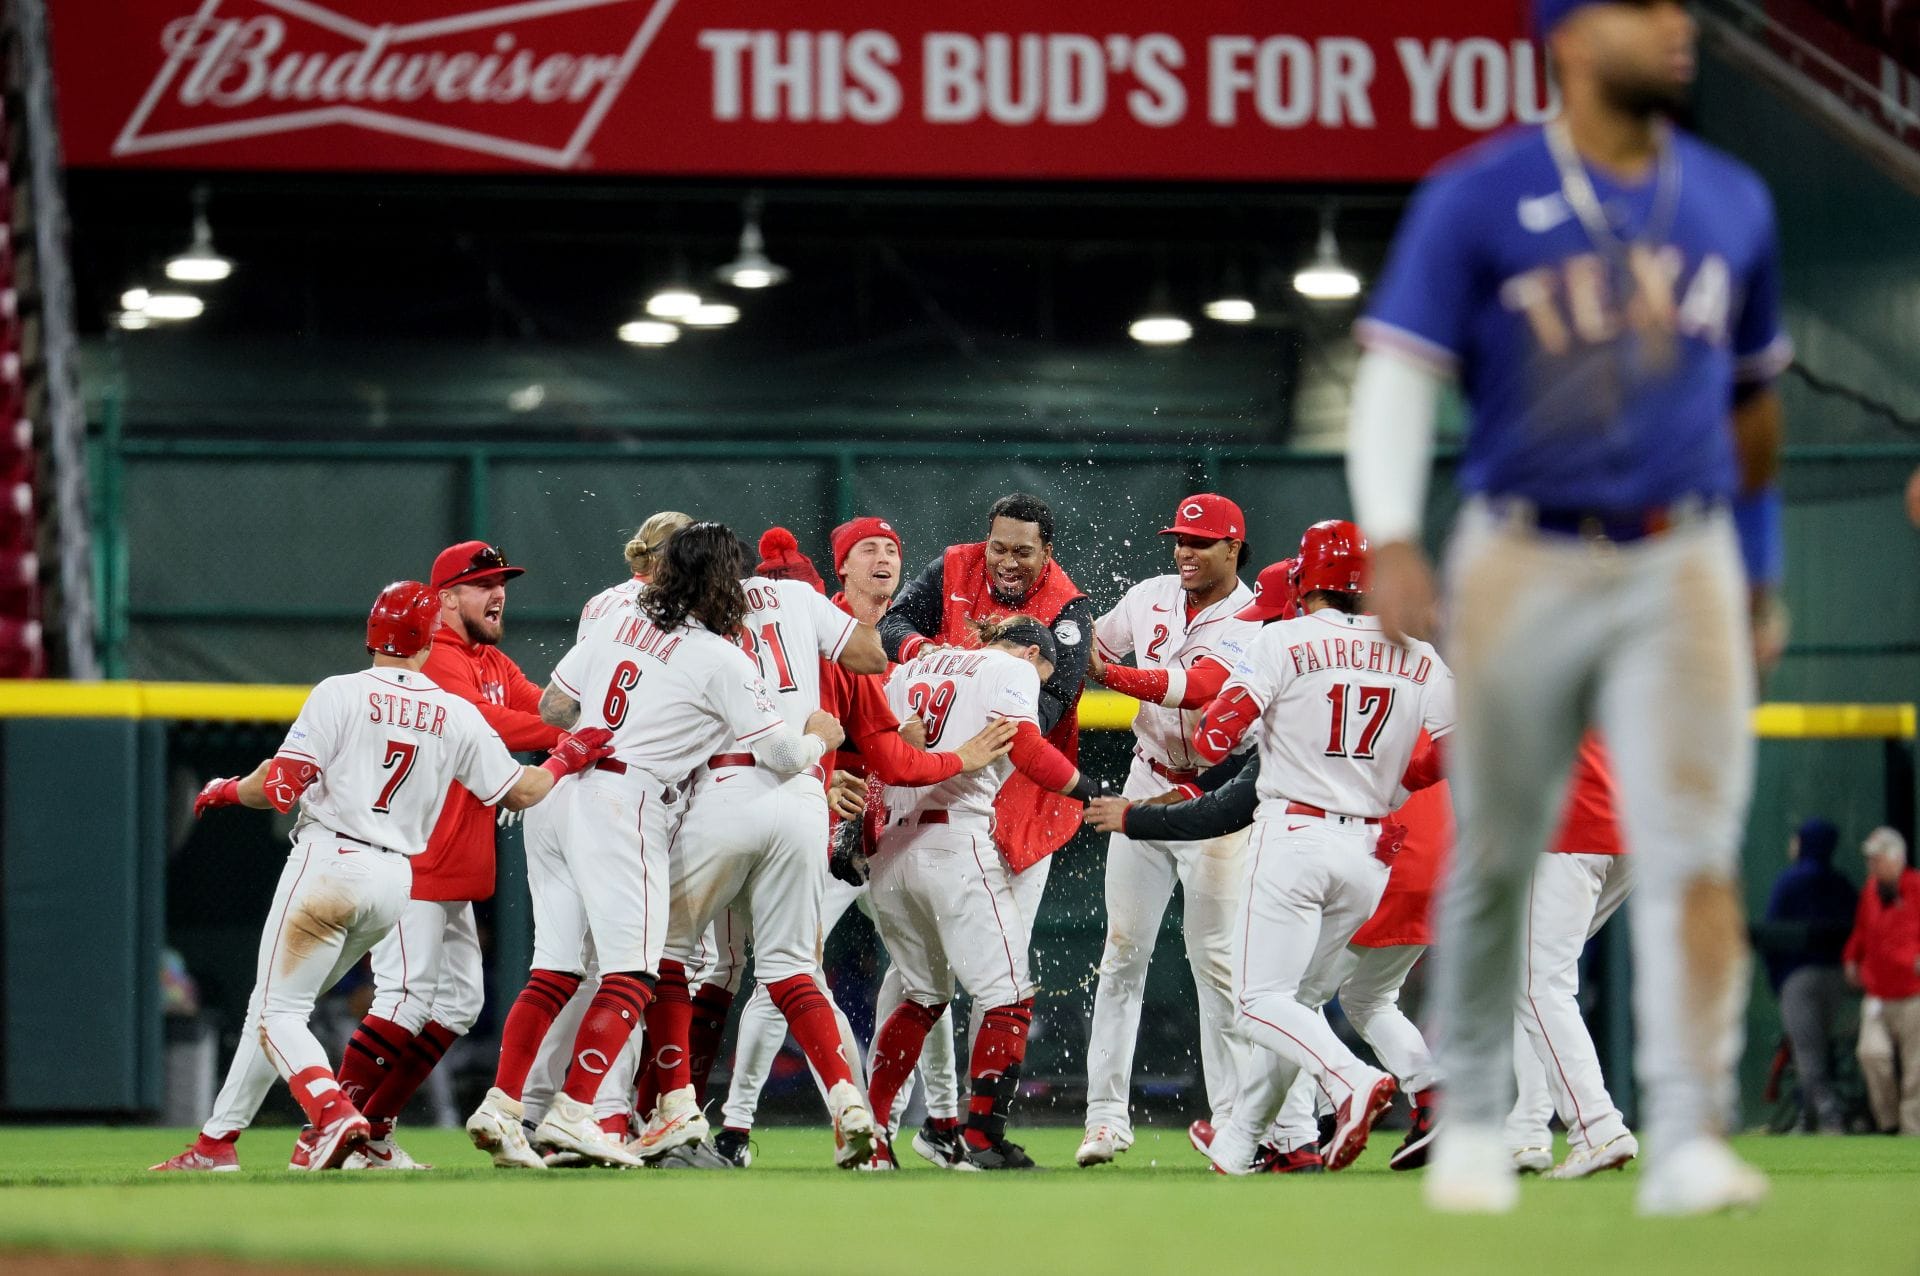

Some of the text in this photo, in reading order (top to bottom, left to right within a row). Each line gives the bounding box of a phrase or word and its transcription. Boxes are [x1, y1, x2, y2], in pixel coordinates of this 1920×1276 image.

[160, 14, 622, 107] Budweiser
[698, 30, 902, 124] THIS
[1207, 35, 1375, 129] FOR
[1394, 37, 1562, 130] YOU
[1182, 503, 1203, 519] C
[613, 616, 682, 664] INDIA
[1145, 624, 1170, 662] 2
[1288, 637, 1433, 685] FAIRCHILD
[368, 692, 447, 739] STEER
[602, 659, 643, 731] 6
[1323, 682, 1396, 760] 17
[371, 740, 419, 814] 7
[577, 1049, 608, 1074] C
[657, 1045, 682, 1069] C
